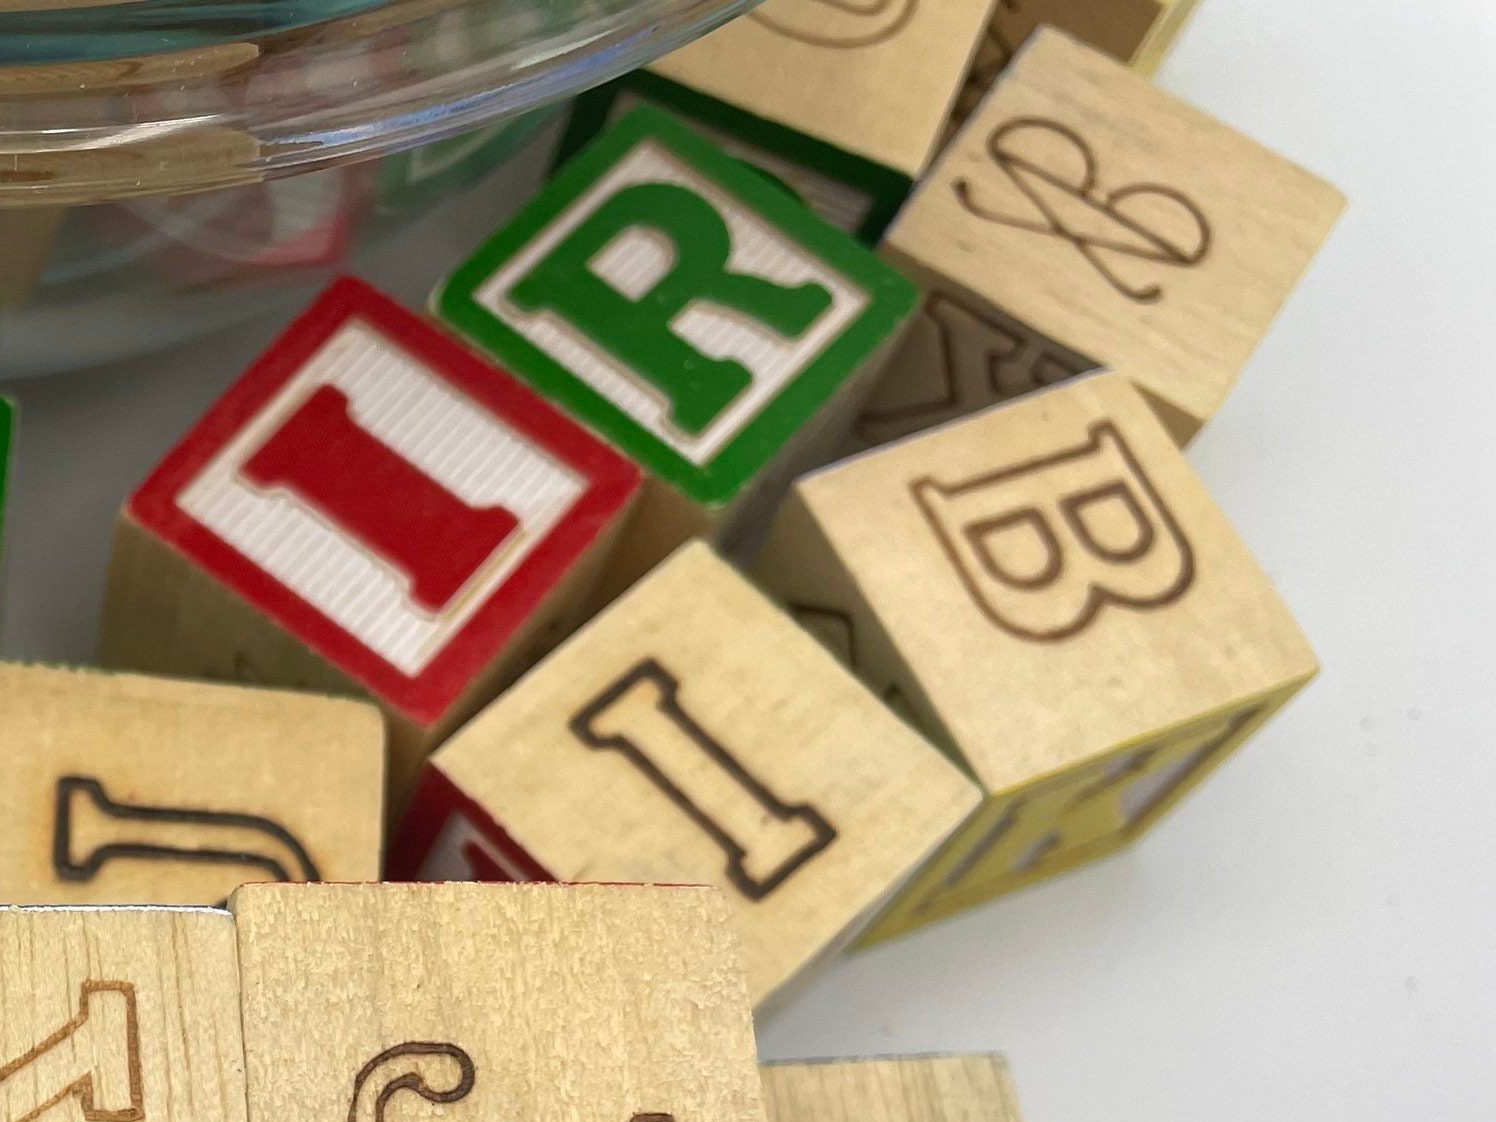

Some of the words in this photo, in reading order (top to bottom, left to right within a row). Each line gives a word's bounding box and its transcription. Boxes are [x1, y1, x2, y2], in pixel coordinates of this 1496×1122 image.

[510, 181, 834, 437] R
[952, 115, 1210, 305] &
[239, 383, 522, 614] I
[909, 419, 1198, 645] B
[569, 656, 838, 901] I
